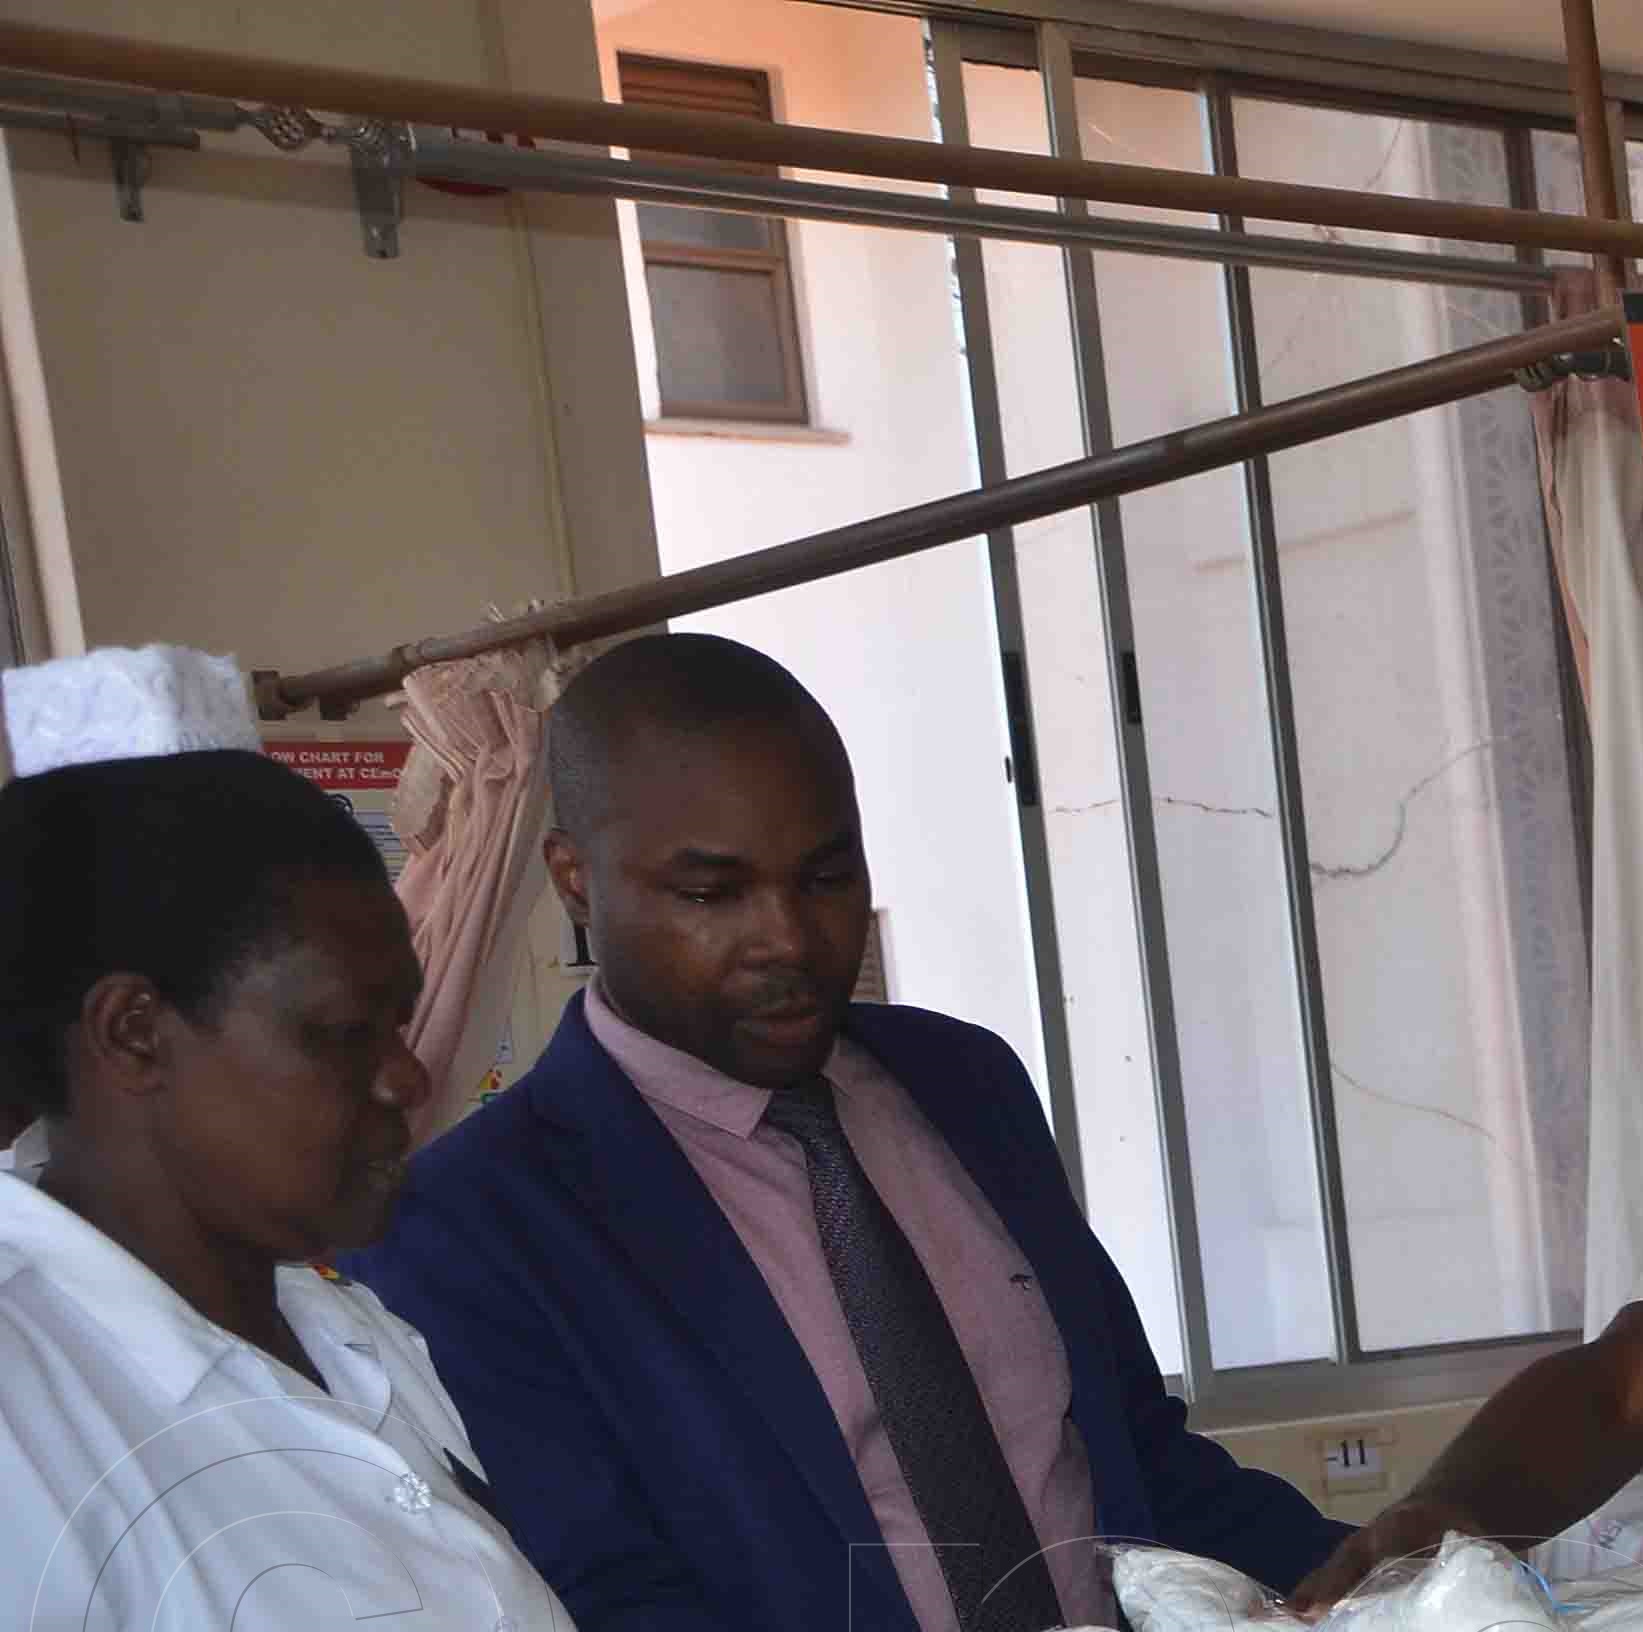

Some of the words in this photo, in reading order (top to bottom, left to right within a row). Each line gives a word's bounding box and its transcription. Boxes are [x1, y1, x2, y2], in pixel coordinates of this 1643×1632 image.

[300, 751, 352, 763] CHART
[354, 751, 385, 763] FOR
[337, 767, 355, 779] AT
